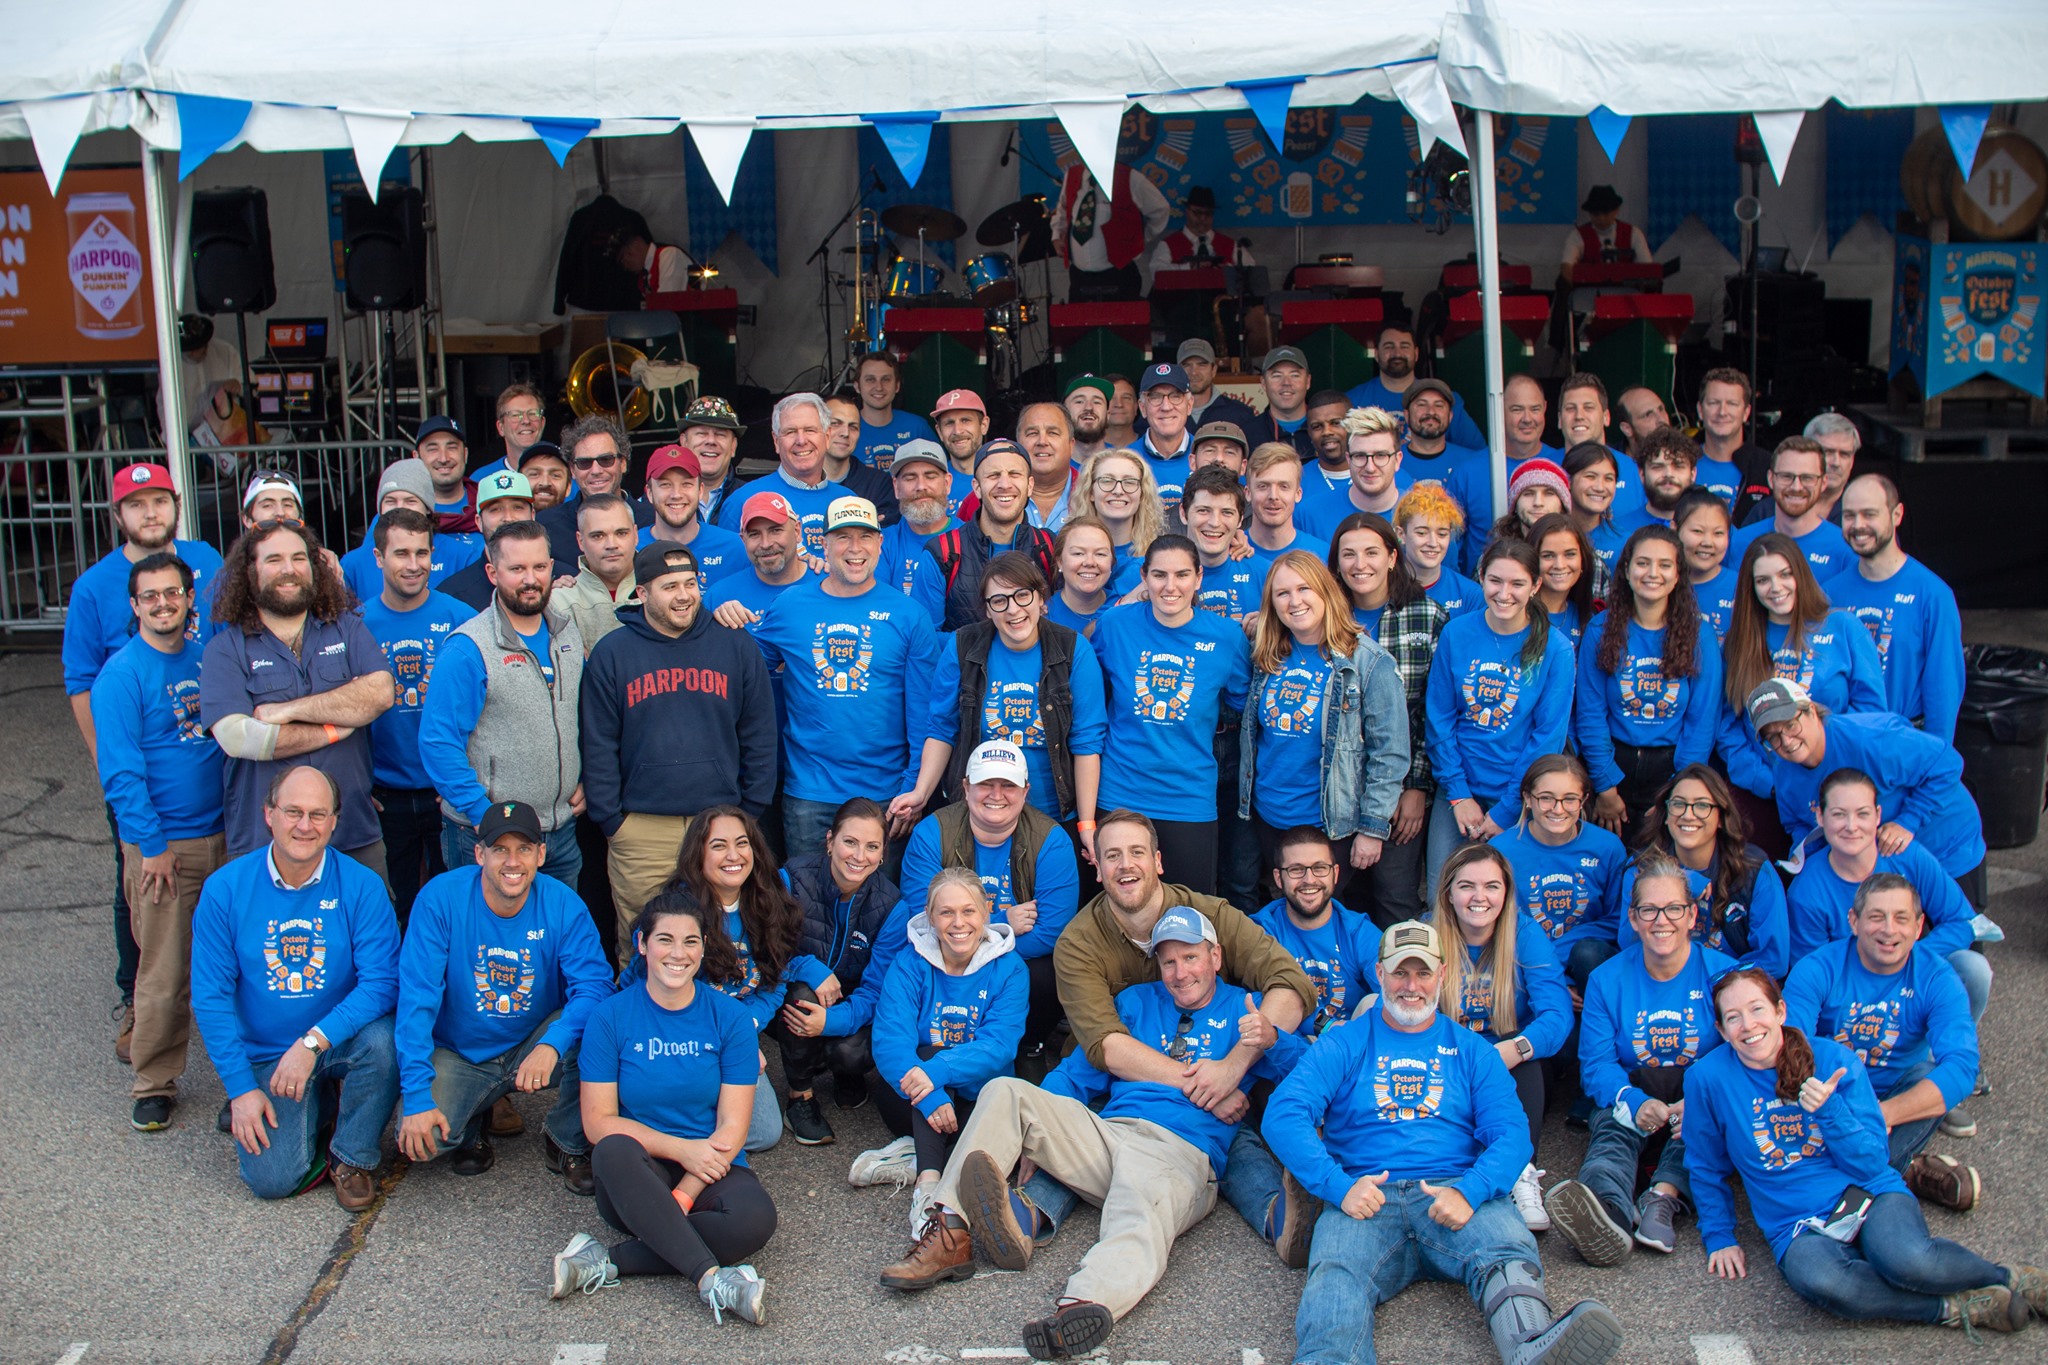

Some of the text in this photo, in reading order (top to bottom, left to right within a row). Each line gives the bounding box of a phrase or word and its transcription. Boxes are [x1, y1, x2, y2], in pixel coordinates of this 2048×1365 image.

[1989, 168, 2012, 207] H
[72, 249, 140, 274] HARPOON
[1969, 288, 2011, 313] fest
[803, 526, 824, 535] Octob
[703, 556, 723, 565] Staff
[1809, 553, 1830, 565] Staff
[430, 562, 443, 572] taff
[1444, 599, 1462, 610] Staff
[1894, 593, 1915, 604] Staff
[868, 610, 891, 621] Staff
[430, 623, 451, 632] Staff
[827, 623, 860, 636] HARPOON
[392, 639, 423, 652] HARPOON
[827, 637, 857, 646] October
[1812, 634, 1834, 645] Staff
[829, 645, 855, 660] fest
[1194, 641, 1216, 652] Staff
[395, 654, 422, 663] October
[1151, 653, 1184, 667] HARPOON
[252, 660, 273, 670] Ethan
[398, 661, 421, 676] fest
[1151, 666, 1181, 677] October
[1285, 668, 1313, 681] HARPOON
[626, 667, 728, 709] HARPOON
[1002, 682, 1034, 694] HARPOON
[1151, 674, 1178, 690] fest
[1281, 680, 1308, 690] October
[1478, 676, 1506, 688] October
[1638, 679, 1662, 693] fest
[1279, 687, 1303, 703] fest
[1478, 685, 1502, 700] fest
[1003, 697, 1033, 706] October
[1005, 704, 1031, 719] fest
[981, 747, 1017, 762] BILLIEVE
[1541, 874, 1573, 886] HARPOON
[1543, 890, 1572, 899] October
[319, 898, 339, 910] Staff
[1546, 897, 1571, 913] fest
[280, 918, 312, 932] HARPOON
[280, 935, 310, 944] October
[283, 943, 308, 958] fest
[487, 947, 519, 961] HARPOON
[488, 961, 517, 973] October
[490, 970, 516, 985] fest
[1466, 995, 1491, 1009] fest
[941, 1004, 969, 1017] HARPOON
[1648, 1010, 1682, 1022] HARPOON
[941, 1019, 966, 1030] October
[1649, 1026, 1681, 1035] October
[942, 1028, 965, 1043] fest
[1652, 1034, 1679, 1049] fest
[648, 1037, 699, 1060] Prost!
[1437, 1045, 1458, 1056] Staff
[1390, 1058, 1427, 1071] HARPOON
[1391, 1073, 1425, 1083] October
[1394, 1081, 1422, 1097] fest
[1769, 1113, 1803, 1124] October
[1773, 1121, 1805, 1140] fest
